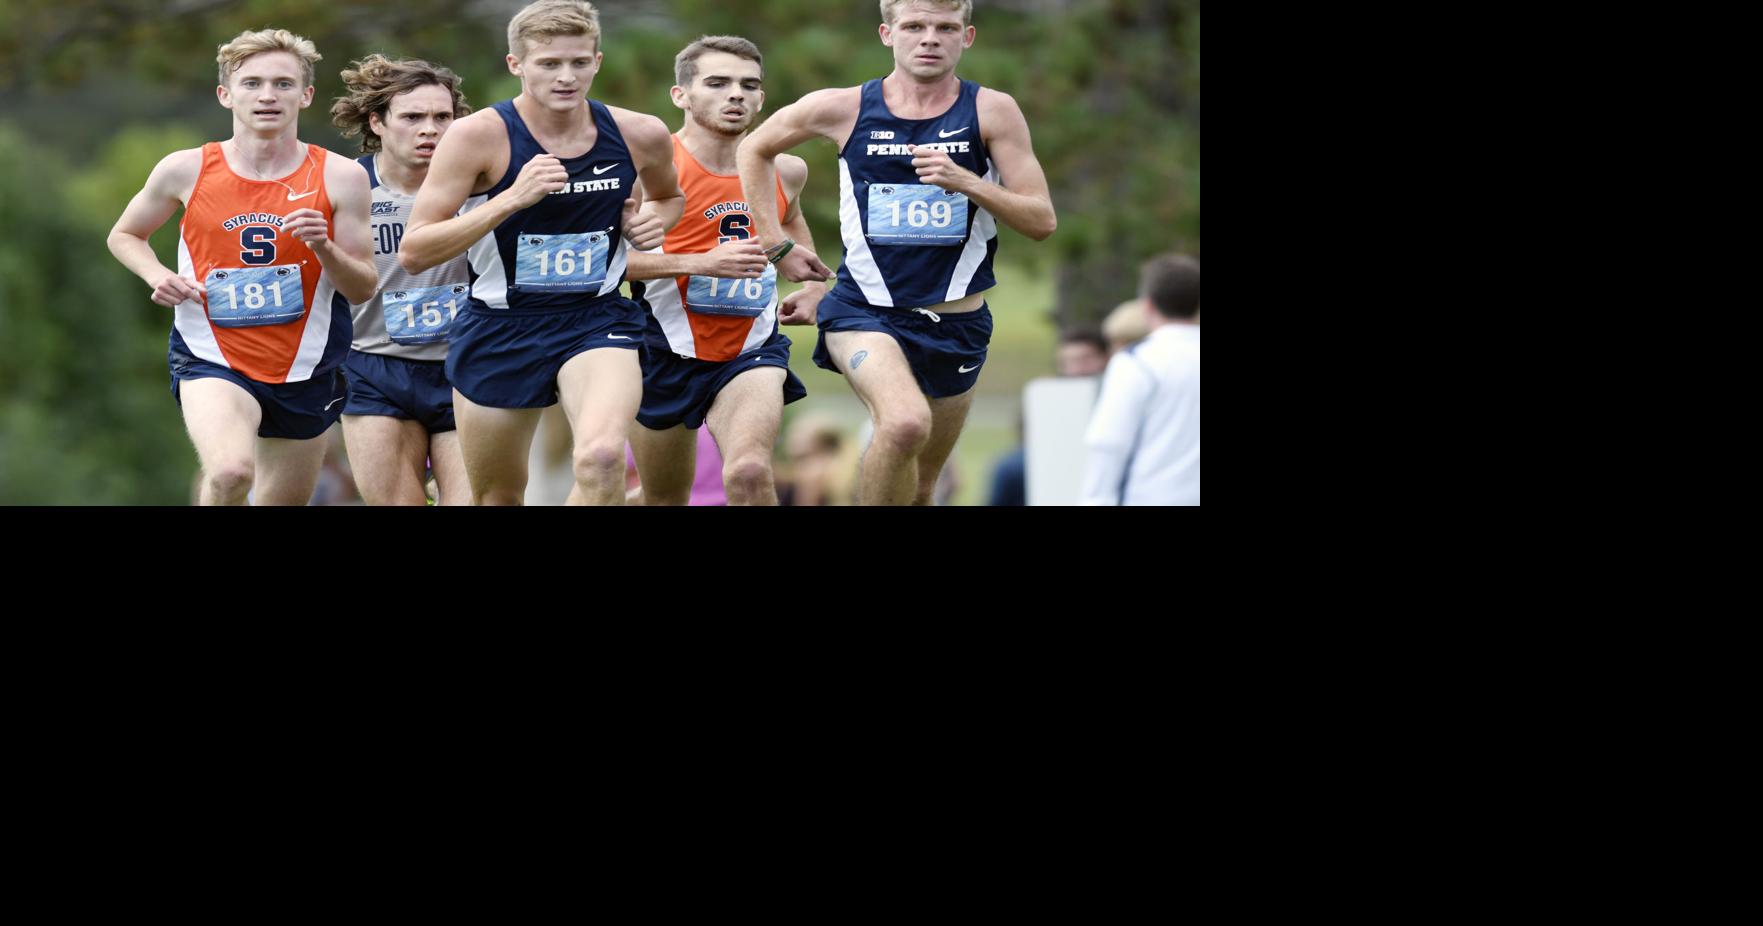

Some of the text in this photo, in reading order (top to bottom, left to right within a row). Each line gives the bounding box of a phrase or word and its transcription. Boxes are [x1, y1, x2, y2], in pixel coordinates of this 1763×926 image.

[573, 178, 620, 193] STATE
[223, 212, 285, 232] SYRACUS
[704, 201, 752, 220] SYRACU
[886, 200, 952, 228] 169
[718, 213, 751, 244] S
[240, 226, 276, 266] S
[535, 249, 592, 276] 161
[222, 281, 283, 310] 181
[401, 299, 458, 328] 151
